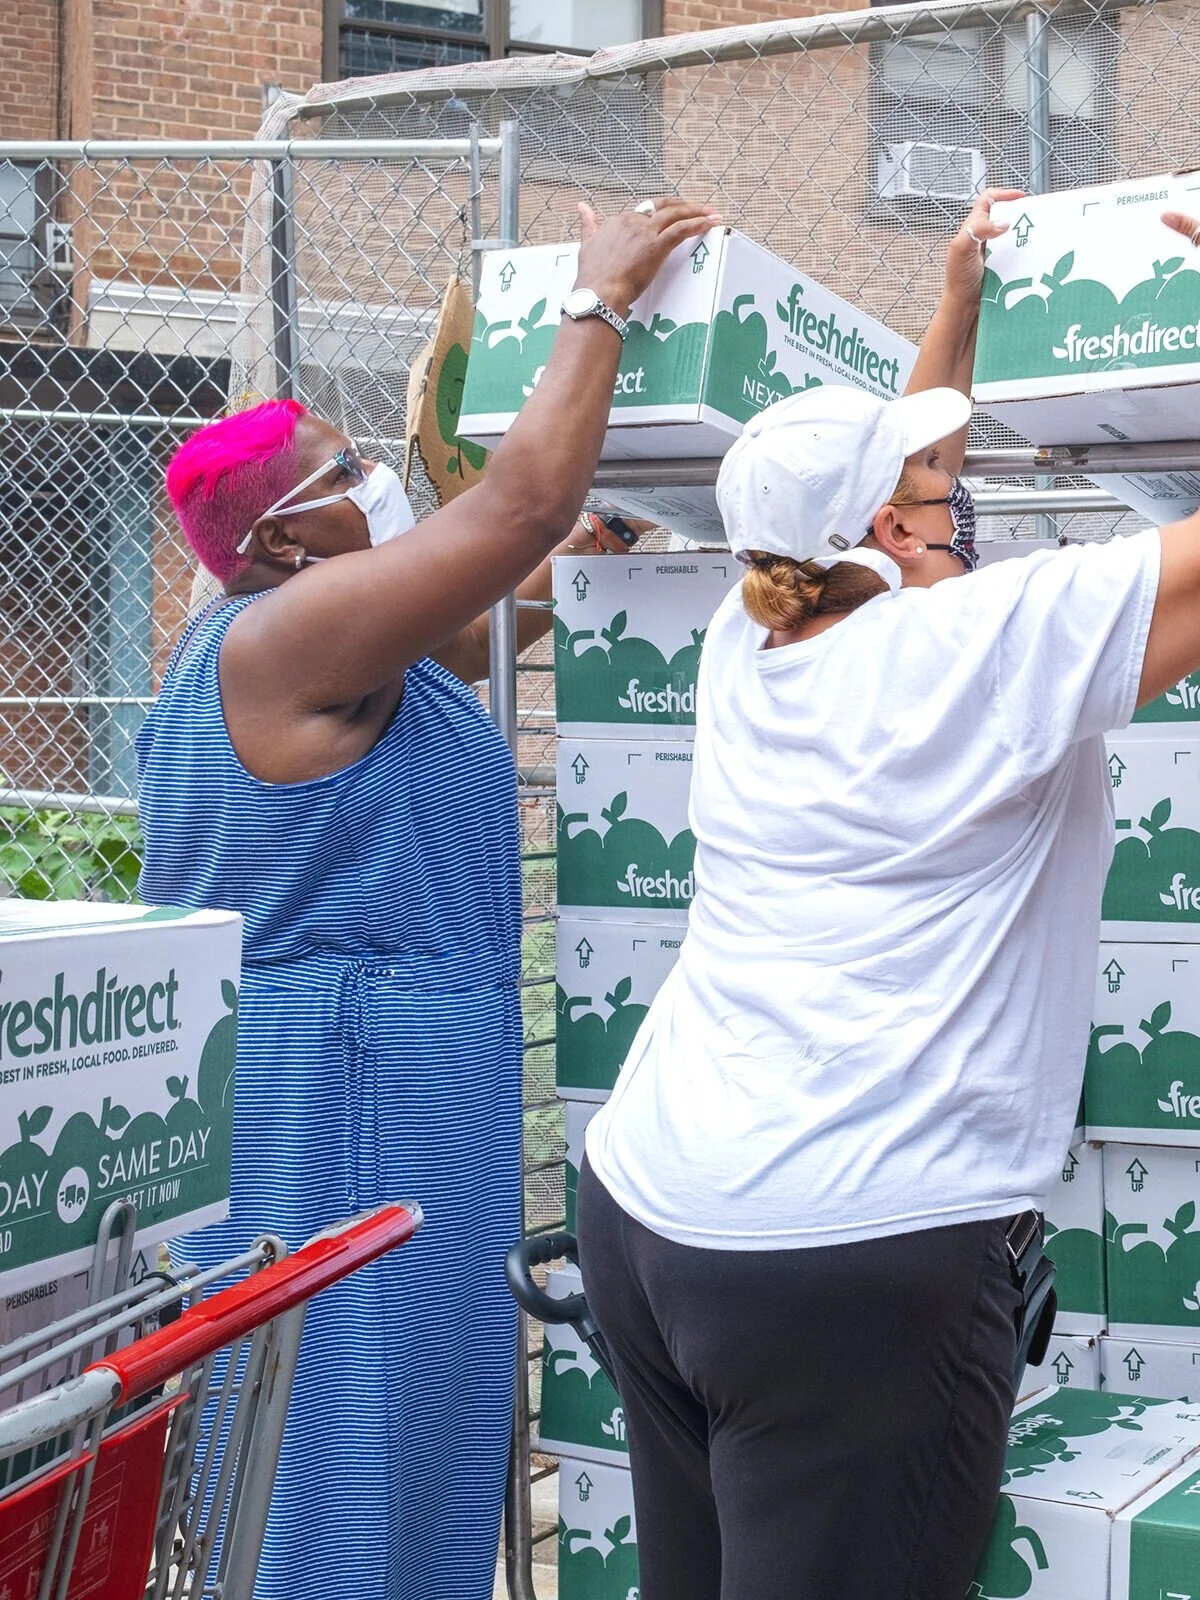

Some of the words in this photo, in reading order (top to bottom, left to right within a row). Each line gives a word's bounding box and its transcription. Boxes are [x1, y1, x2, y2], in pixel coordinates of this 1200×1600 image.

[1116, 190, 1168, 205] PERISHABLES
[1015, 238, 1028, 247] UP
[692, 264, 704, 274] UP
[501, 284, 511, 293] UP
[787, 283, 899, 394] freshdirect
[784, 335, 794, 347] THE
[796, 341, 808, 355] BEST
[742, 374, 784, 406] NEXT
[655, 565, 699, 574] PERISHABLES
[576, 593, 587, 602] UP
[626, 678, 695, 713] freshd
[655, 752, 694, 761] PERISHABLE
[576, 776, 586, 785] UP
[625, 863, 694, 899] freshd
[660, 939, 684, 949] PERISH
[579, 960, 590, 969] UP
[1108, 984, 1121, 994] UP
[0, 966, 179, 1058] reshdirect
[23, 1064, 34, 1081] IN
[36, 1060, 70, 1079] FRESH,
[72, 1054, 101, 1072] LOCAL
[103, 1050, 131, 1066] FOOD.
[132, 1039, 179, 1060] DELIVERED.
[97, 1140, 162, 1189] SAME
[168, 1126, 212, 1169] DAY
[1062, 1173, 1075, 1183] UP
[147, 1186, 157, 1208] IT
[159, 1178, 181, 1204] NOW
[1131, 1183, 1144, 1193] UP
[6, 1280, 58, 1312] PERISHABLES
[1056, 1375, 1069, 1385] UP
[1128, 1372, 1140, 1382] UP
[579, 1493, 590, 1502] UP
